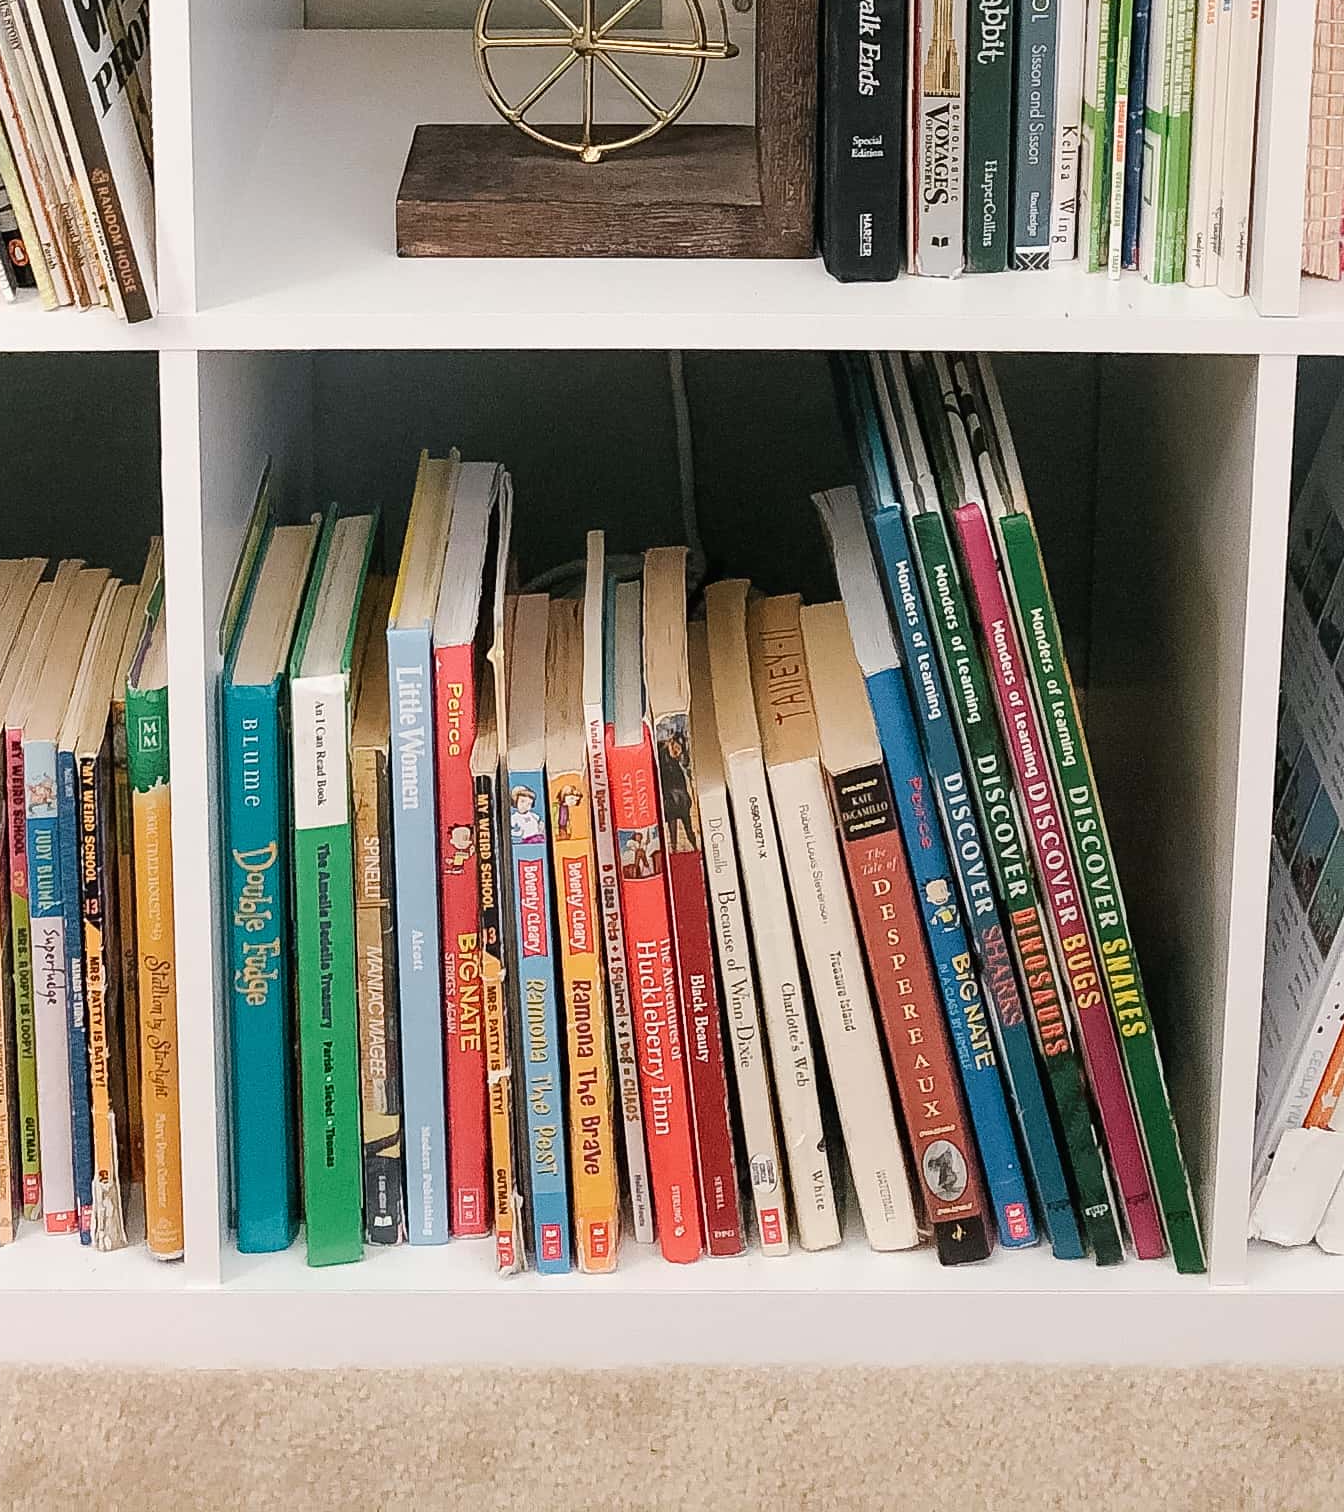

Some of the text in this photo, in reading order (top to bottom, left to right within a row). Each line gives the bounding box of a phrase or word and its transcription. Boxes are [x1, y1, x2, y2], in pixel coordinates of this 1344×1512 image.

[859, 41, 882, 96] Ends
[1031, 45, 1046, 87] Sisson
[1029, 91, 1044, 118] and
[852, 136, 882, 144] Special
[852, 149, 883, 158] Edition
[924, 103, 950, 205] VOYAGES
[950, 104, 960, 202] SCHOLASTIC
[1028, 122, 1043, 164] Sisson
[1059, 126, 1077, 179] Kelisa
[860, 213, 872, 256] HARPER
[982, 160, 998, 246] HarperCollins
[1029, 192, 1039, 236] Routledge
[1051, 198, 1075, 243] Wing
[96, 185, 124, 245] RANDOM
[113, 249, 137, 294] HOUSE
[315, 700, 326, 716] An
[315, 727, 326, 748] Can
[396, 666, 424, 810] Little Women
[315, 751, 327, 777] Read
[316, 780, 327, 806] Book
[84, 767, 97, 883] MY WEIRD SCHOOL
[231, 841, 278, 932] Double
[446, 682, 464, 756] Peirce
[458, 974, 479, 1052] NATE
[1027, 780, 1102, 1009] DISCOVER BUGS
[33, 829, 60, 1006] JUDY BLUME Superfudge
[1067, 786, 1147, 1038] DISCOVER SNAKES
[235, 940, 279, 1006] Fudge
[634, 940, 673, 1135] Huckleberry Finn
[689, 974, 711, 1063] Black Beauty
[571, 979, 604, 1176] Ramona The Brave
